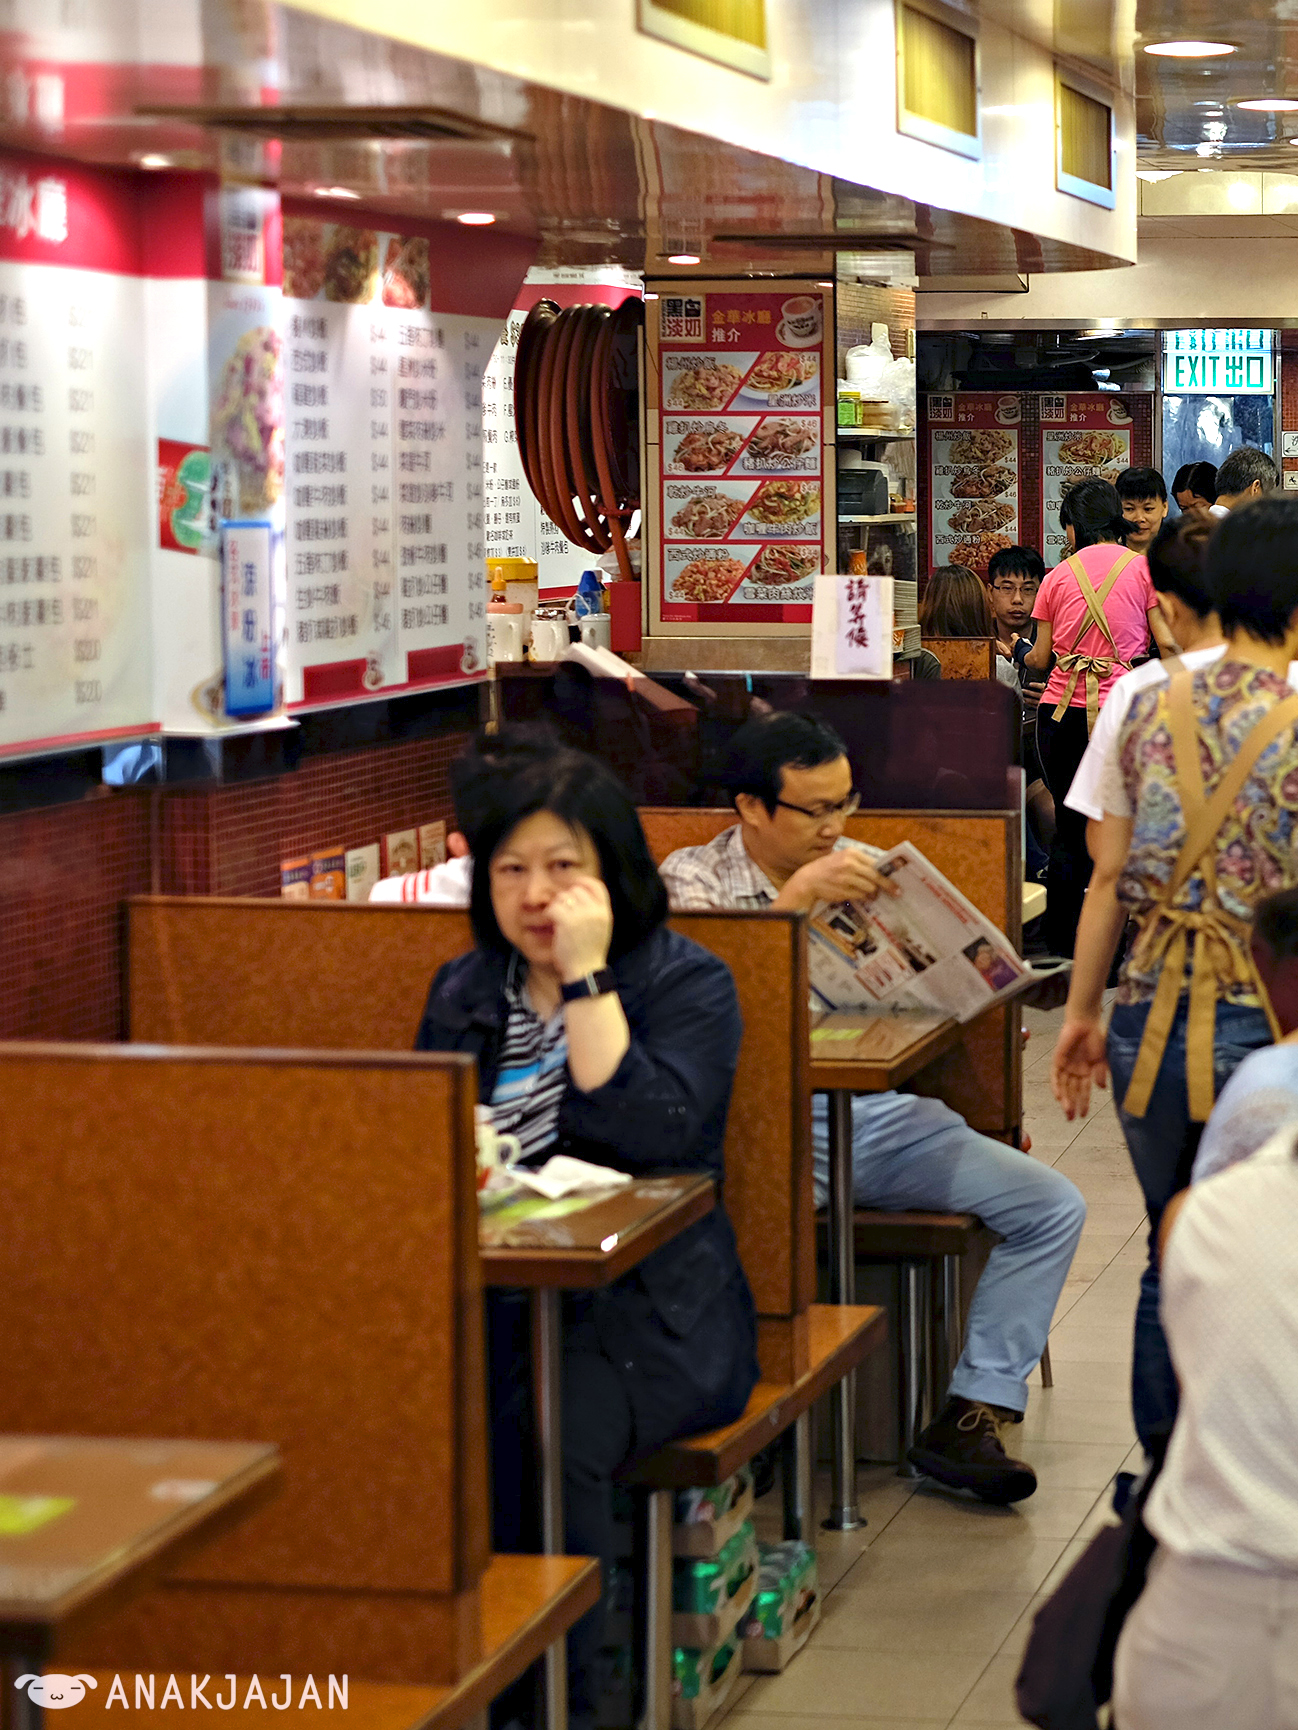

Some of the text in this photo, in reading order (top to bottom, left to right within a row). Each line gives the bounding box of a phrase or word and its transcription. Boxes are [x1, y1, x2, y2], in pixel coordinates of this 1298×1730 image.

[711, 309, 772, 325] 金華冰廳
[666, 318, 701, 338] 淡奶
[711, 327, 741, 343] 推介
[1175, 355, 1264, 388] EXIT 出口
